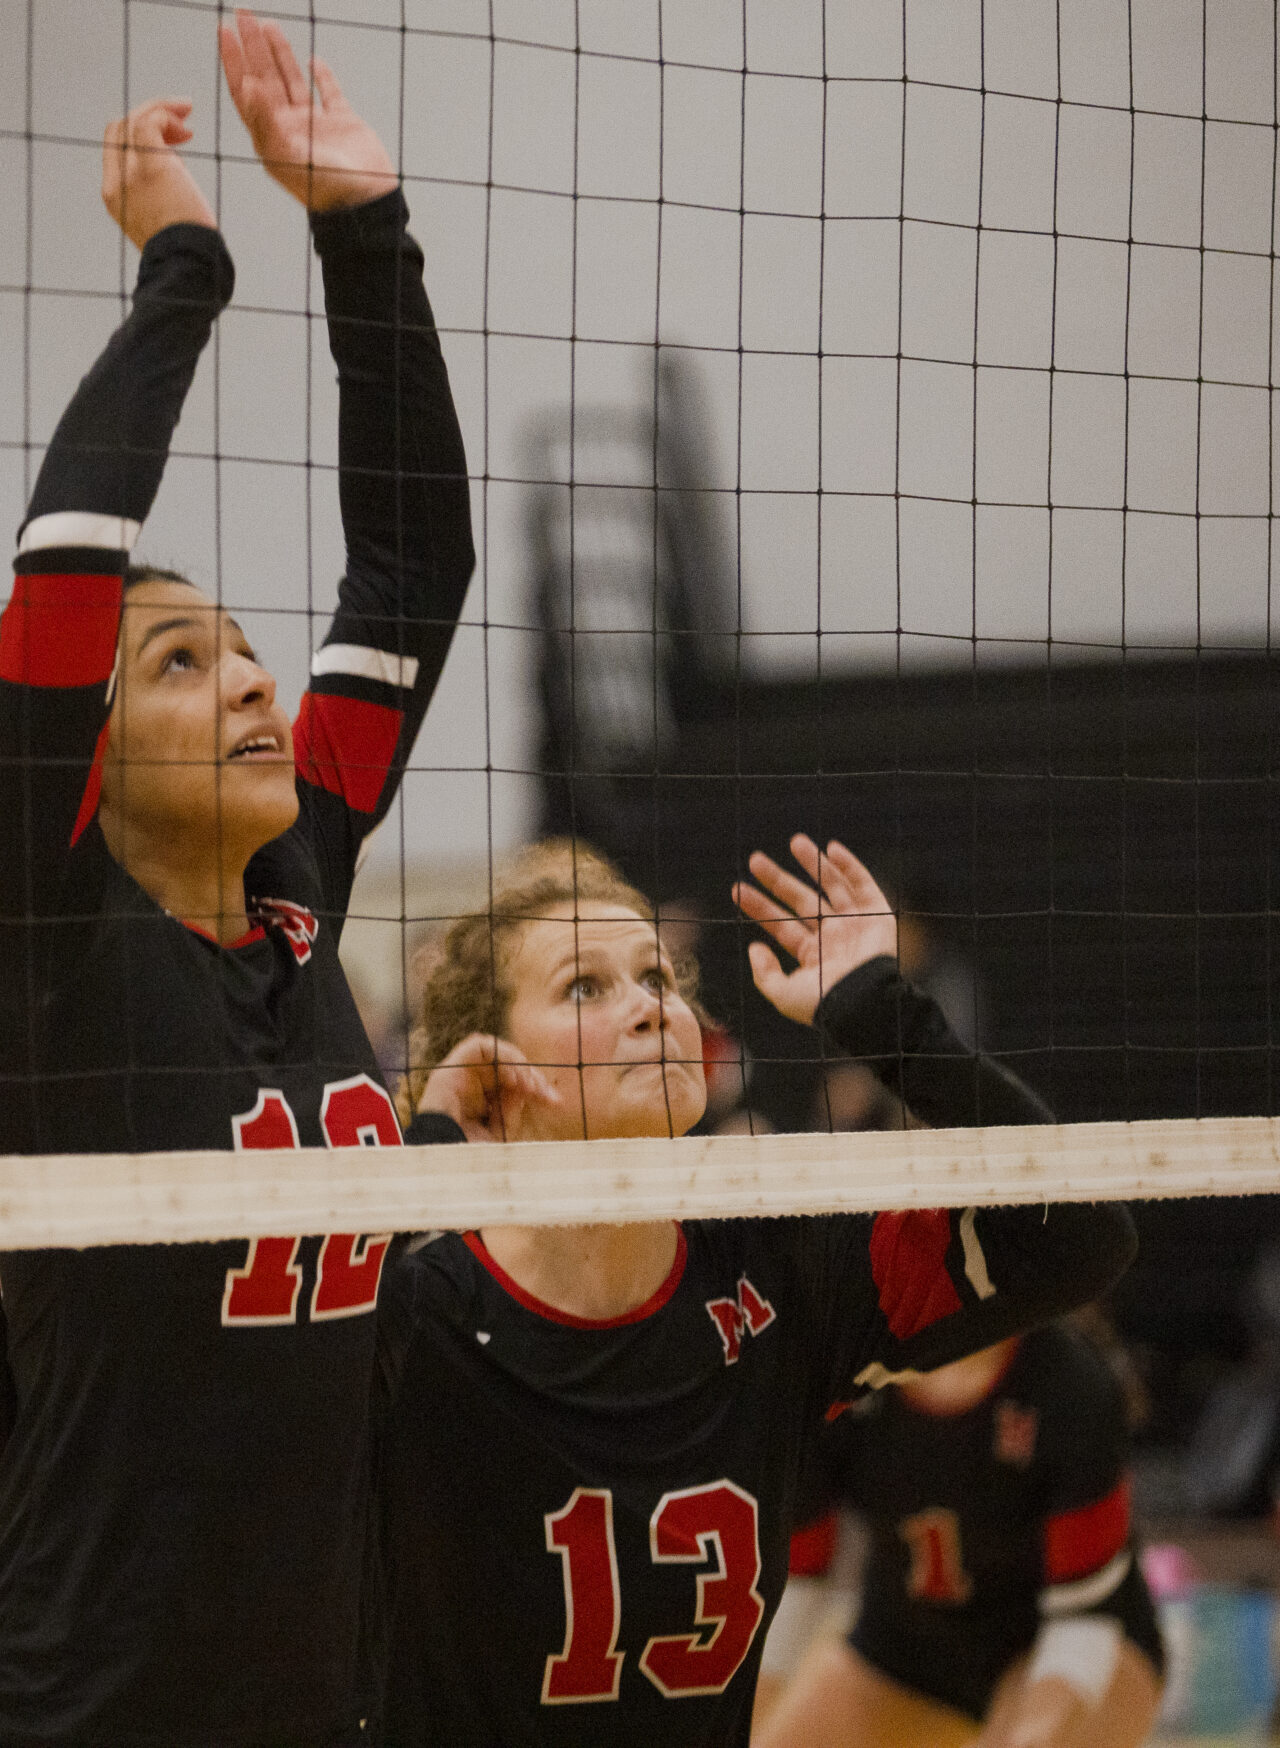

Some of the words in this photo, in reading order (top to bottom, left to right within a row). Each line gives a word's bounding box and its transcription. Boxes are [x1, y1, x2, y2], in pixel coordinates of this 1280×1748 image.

[221, 1072, 404, 1327] 12
[705, 1275, 776, 1367] M
[540, 1478, 765, 1705] 13
[903, 1507, 970, 1603] 1
